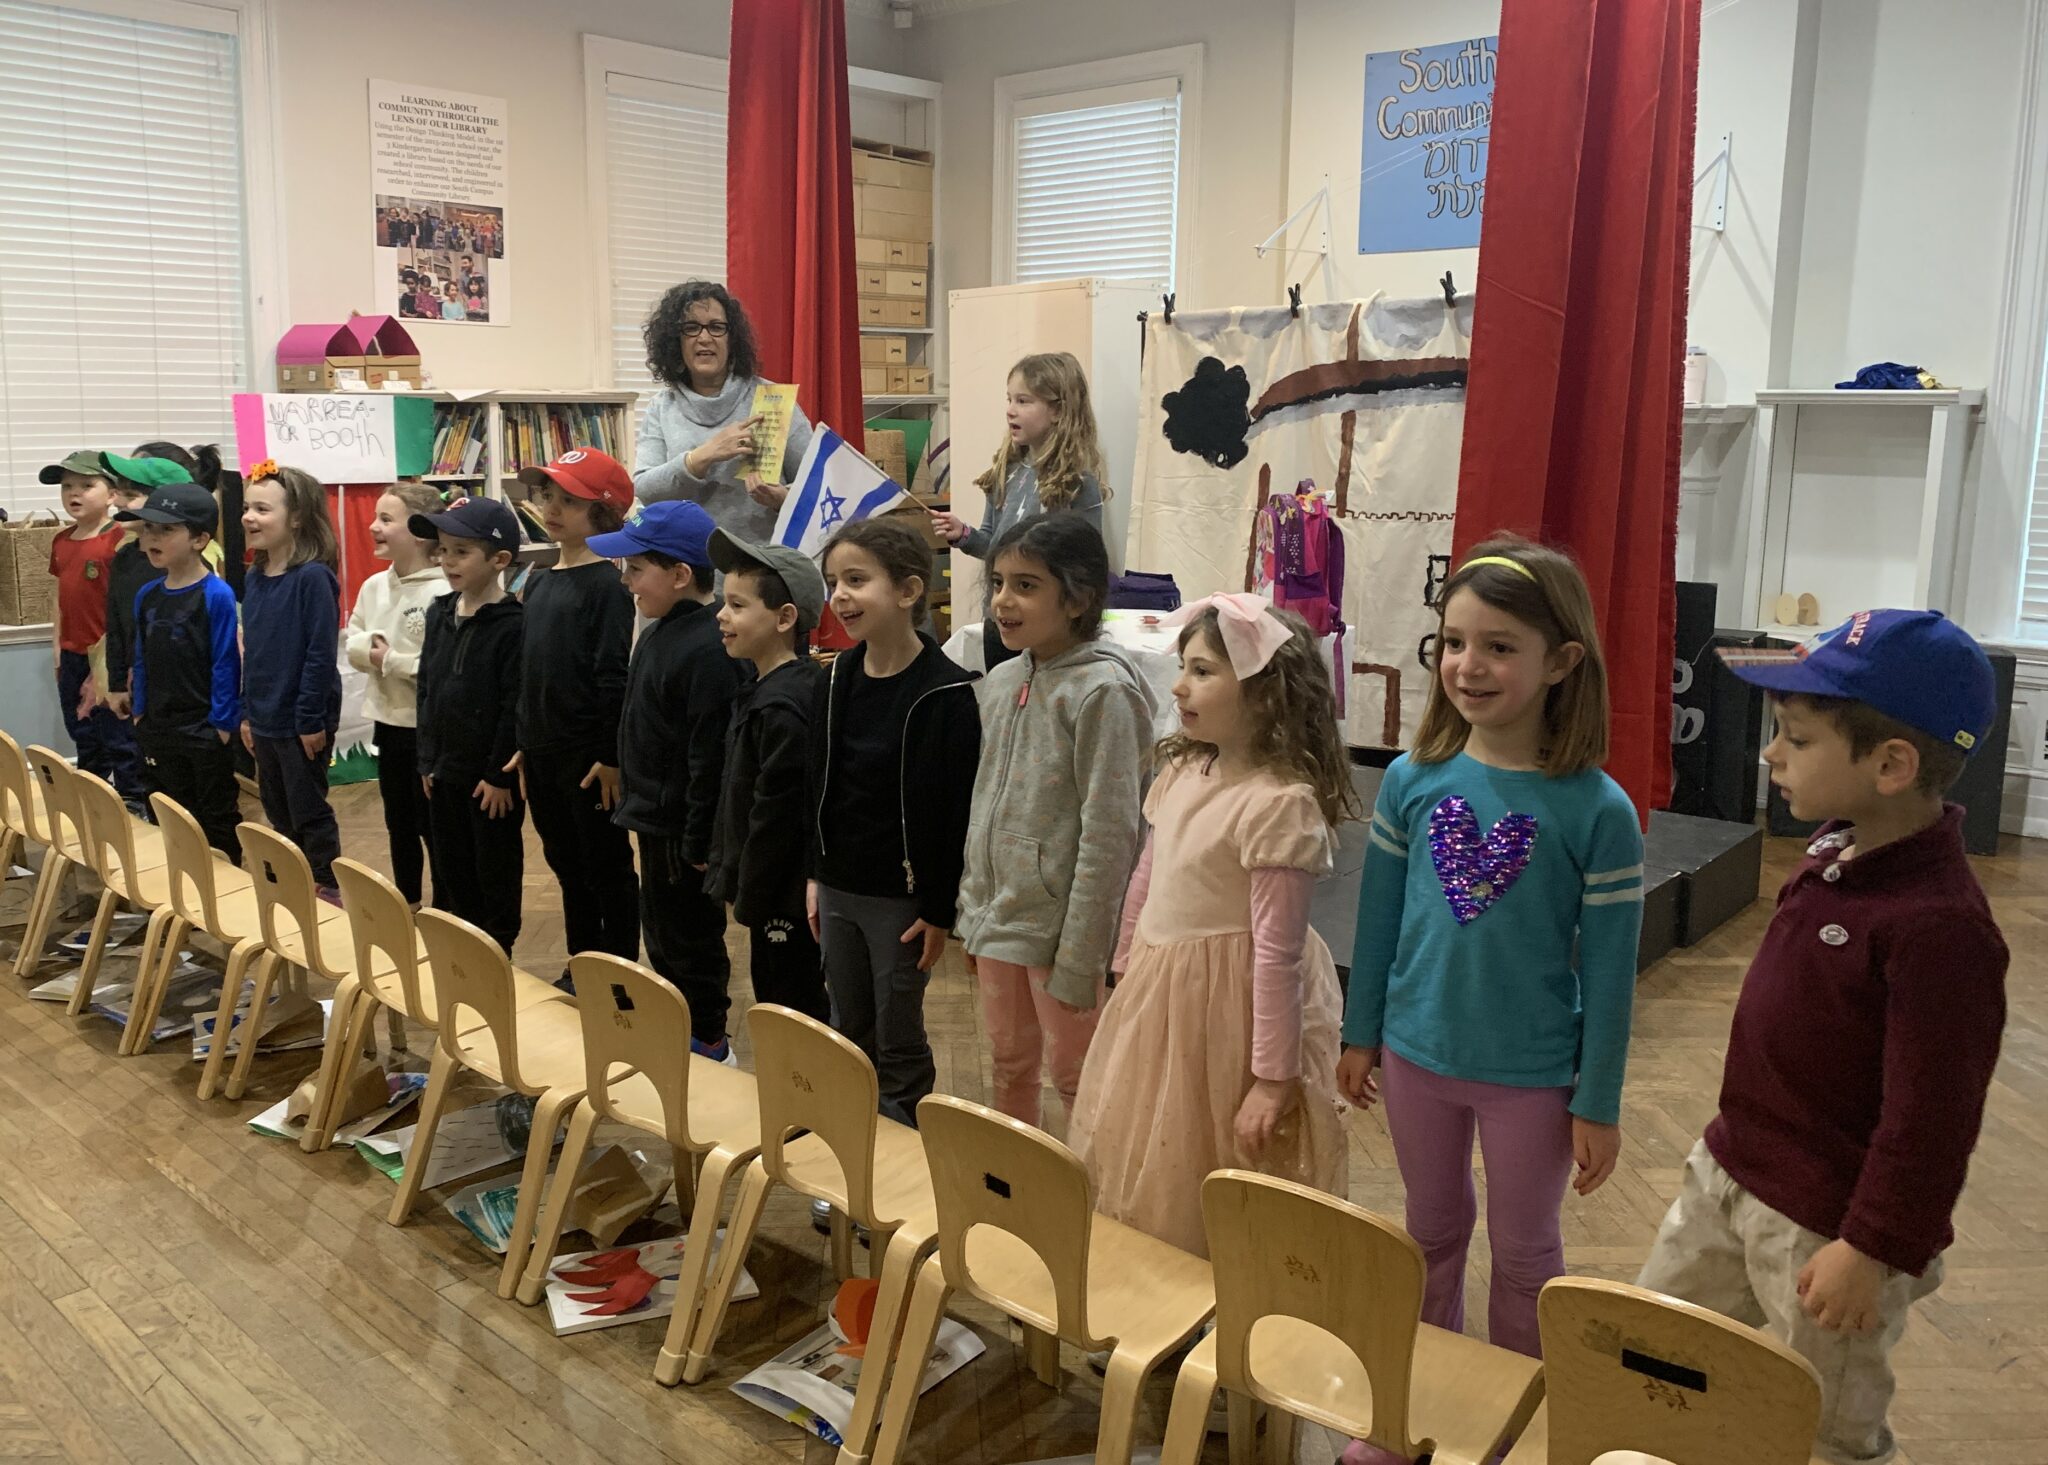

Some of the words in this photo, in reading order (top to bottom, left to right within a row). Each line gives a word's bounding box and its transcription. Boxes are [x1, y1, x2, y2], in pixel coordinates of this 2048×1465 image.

[1399, 38, 1497, 94] South
[379, 102, 436, 117] COMMUNITY
[437, 111, 479, 123] THROUGH
[481, 117, 499, 126] THE
[402, 95, 446, 109] LEARNING
[450, 103, 478, 113] ABOUT
[392, 114, 415, 125] LENS
[416, 118, 427, 127] OF
[430, 120, 448, 129] OUR
[451, 123, 487, 134] LIBRARY
[394, 123, 404, 131] the
